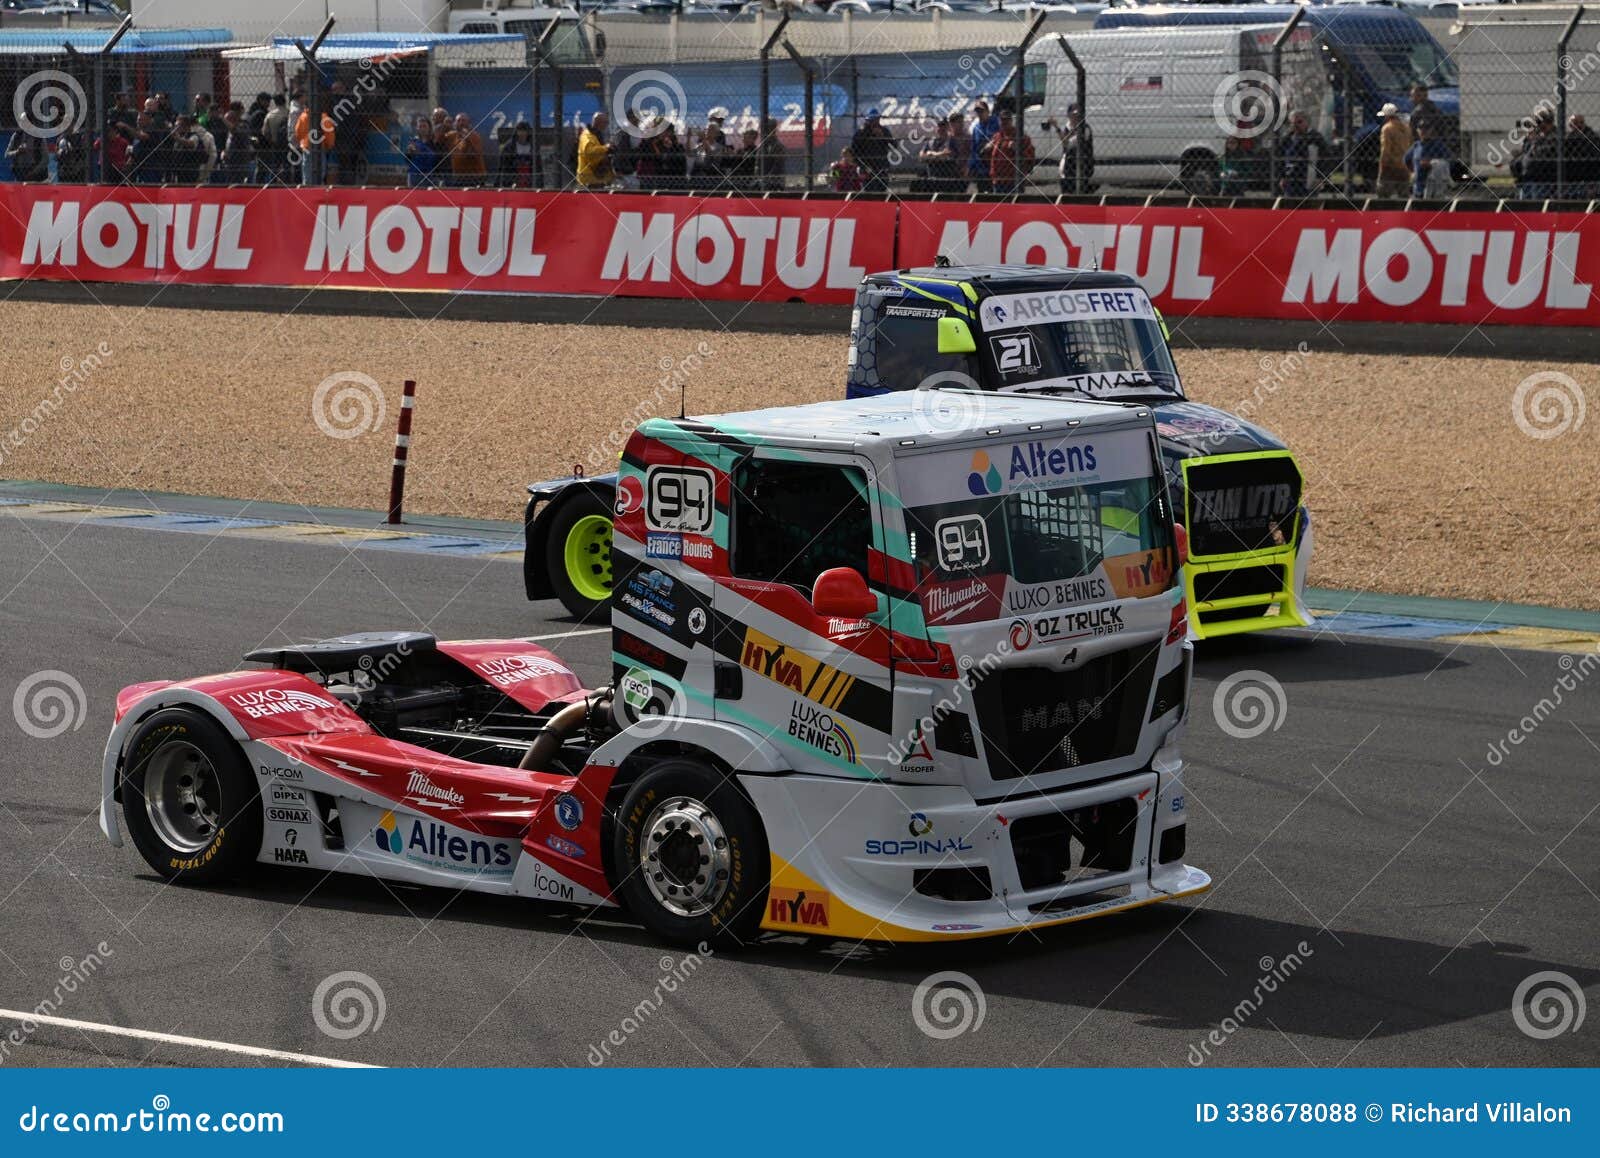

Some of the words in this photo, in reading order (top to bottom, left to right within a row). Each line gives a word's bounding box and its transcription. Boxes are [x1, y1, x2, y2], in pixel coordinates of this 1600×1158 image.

[20, 200, 253, 271] MOTUL
[304, 204, 548, 278] MOTUL
[600, 210, 867, 290] MOTUL
[1281, 226, 1594, 310] MOTUL
[1012, 291, 1138, 321] ARCOSFRET
[999, 337, 1032, 369] 21
[1009, 441, 1097, 481] Altens
[657, 477, 704, 521] 94
[1192, 487, 1243, 524] TEAM
[1245, 482, 1292, 517] VTR
[647, 536, 681, 555] France
[682, 540, 713, 559] Routes
[942, 525, 983, 562] 94
[924, 580, 989, 615] Milwaukee
[1008, 586, 1050, 611] LUXO
[1055, 578, 1106, 604] BENNES
[828, 617, 872, 634] Milwaukee
[1035, 616, 1061, 637] OZ
[1065, 605, 1124, 631] TRUCK
[1092, 623, 1125, 636] TP/BTP
[475, 655, 526, 675] LUXO
[491, 664, 558, 686] BENNES
[743, 641, 804, 693] HYVA
[230, 688, 288, 707] LUXO
[623, 676, 650, 699] reca
[243, 699, 316, 719] BENNES
[792, 700, 834, 732] LUXO
[788, 719, 842, 757] BENNES
[900, 765, 935, 774] LUSOFER
[406, 769, 465, 804] Milwaukee
[269, 808, 310, 822] SONAX
[274, 848, 309, 865] HAFA
[408, 819, 512, 866] Altens
[865, 837, 974, 855] SOPINAL
[771, 892, 829, 926] HYVA
